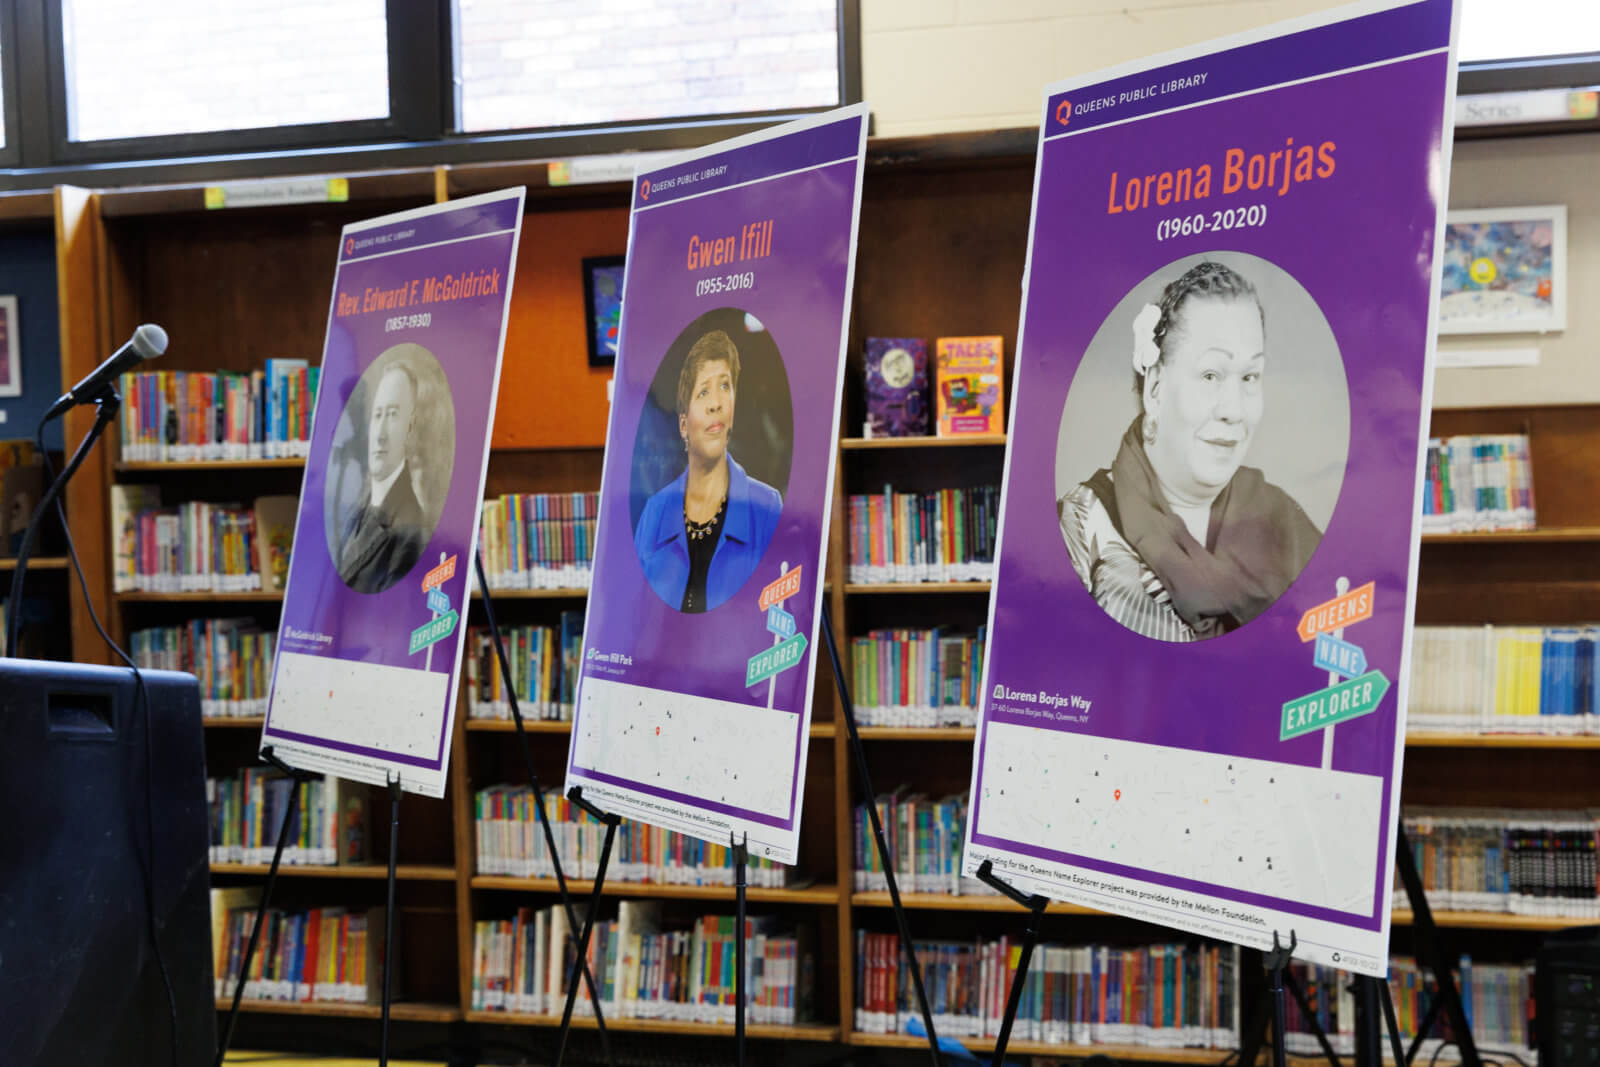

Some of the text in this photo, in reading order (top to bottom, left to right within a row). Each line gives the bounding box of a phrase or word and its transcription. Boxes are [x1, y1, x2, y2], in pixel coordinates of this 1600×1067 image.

[1074, 96, 1116, 115] QUEENS
[1119, 85, 1157, 105] PUBLIC
[1161, 72, 1208, 95] LIBRARY
[1464, 101, 1522, 121] Series
[651, 178, 676, 193] QUEENS
[676, 171, 699, 186] PUBLIC
[700, 165, 728, 180] LIBRARY
[1107, 137, 1337, 215] Lorena Borjas
[1156, 204, 1268, 241] (1960-2020)
[687, 219, 774, 271] Gwen Ifill
[336, 268, 500, 317] Rev. Edward F. McGoldrick
[696, 272, 754, 297] (1955-2016)
[385, 313, 432, 332] (1857-1930)
[945, 342, 994, 359] TALES
[764, 573, 798, 606] QUEENS
[770, 609, 792, 636] NAME
[1306, 593, 1368, 634] QUEENS
[749, 641, 799, 680] EXPLORER
[1319, 639, 1359, 673] NAME
[1005, 687, 1092, 713] Lorena Borjas Way
[1286, 682, 1373, 731] EXPLORER
[1008, 859, 1018, 869] for
[1018, 862, 1028, 871] the
[1029, 864, 1052, 877] Queens
[1054, 871, 1071, 882] Name
[1072, 874, 1100, 888] Explorer
[1100, 881, 1125, 894] project
[1125, 889, 1138, 897] was
[1139, 890, 1170, 904] provided
[1170, 897, 1180, 908] by
[1181, 900, 1193, 909] the
[1195, 902, 1220, 915] Mellon
